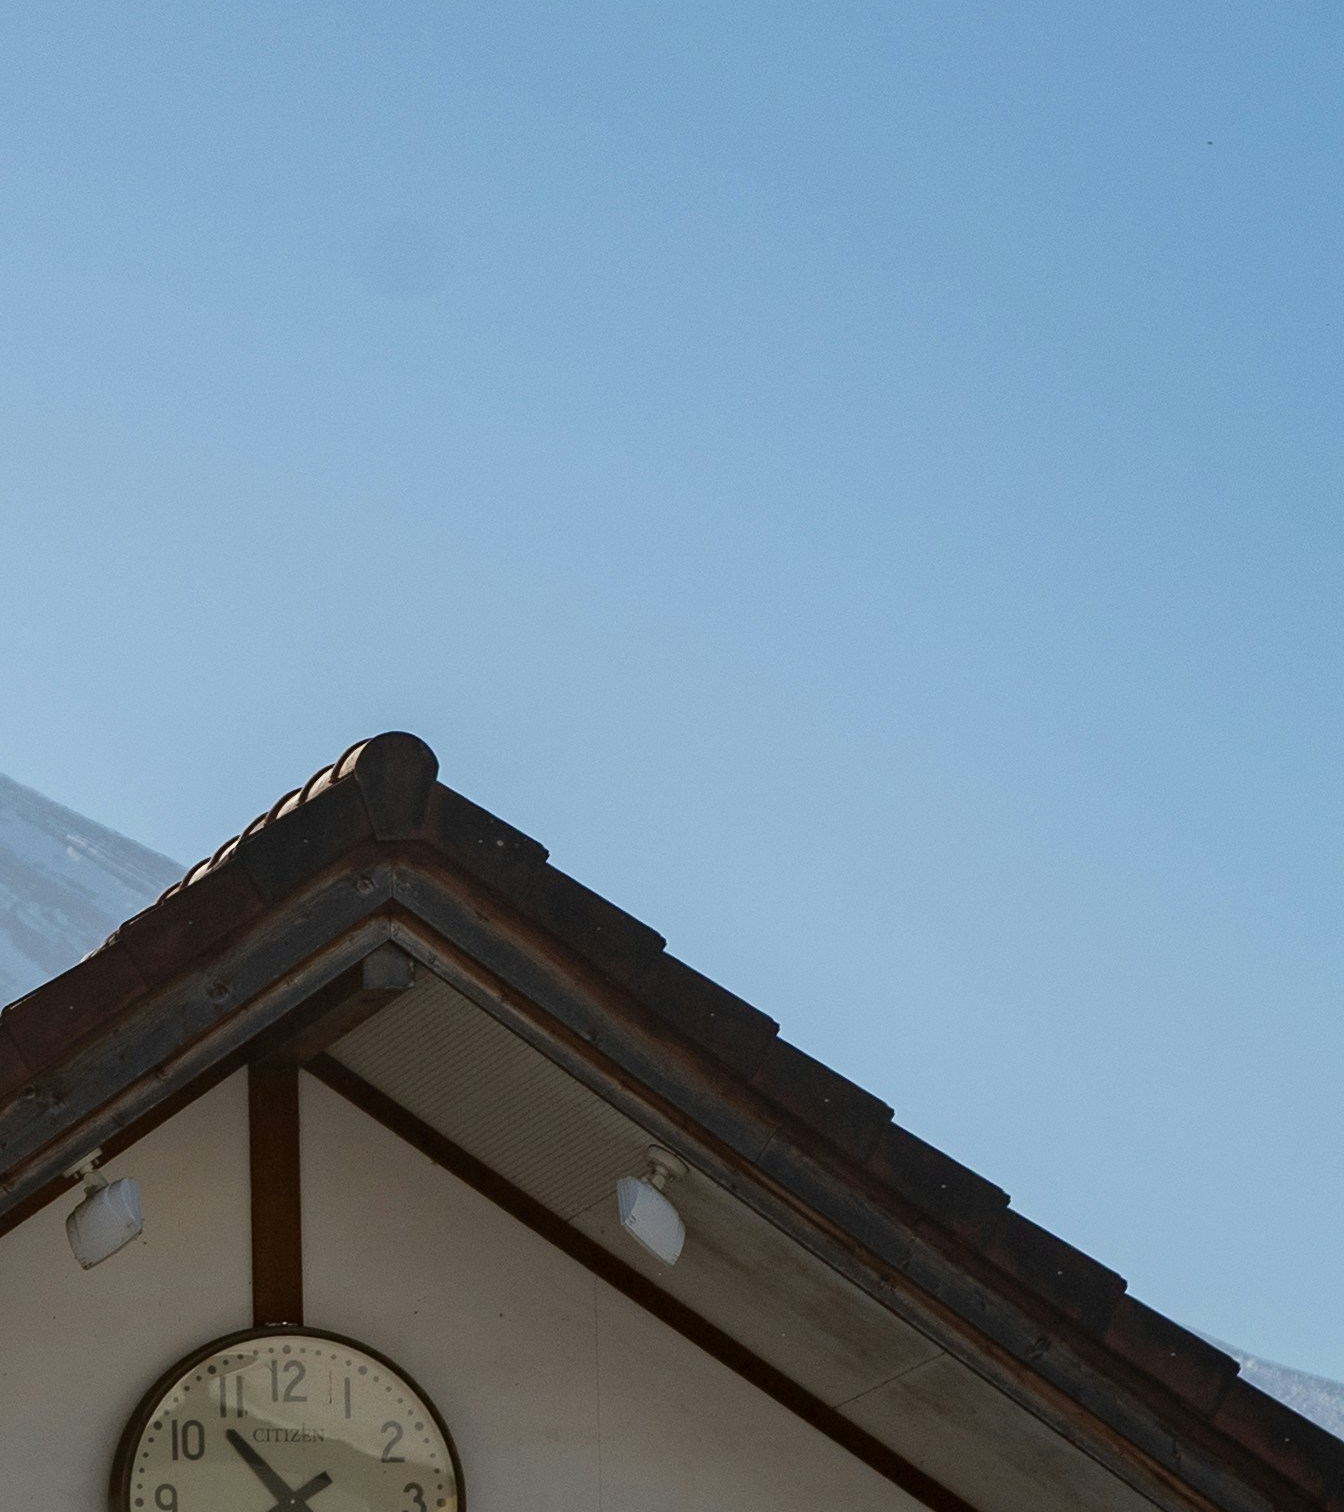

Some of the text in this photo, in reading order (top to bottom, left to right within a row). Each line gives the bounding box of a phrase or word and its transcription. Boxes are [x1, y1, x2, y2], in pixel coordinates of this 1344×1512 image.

[219, 1376, 244, 1419] 11
[271, 1359, 308, 1403] 12
[344, 1377, 352, 1419] 1
[171, 1419, 206, 1461] 10
[252, 1428, 325, 1443] CITIZEN
[380, 1420, 406, 1464] 2
